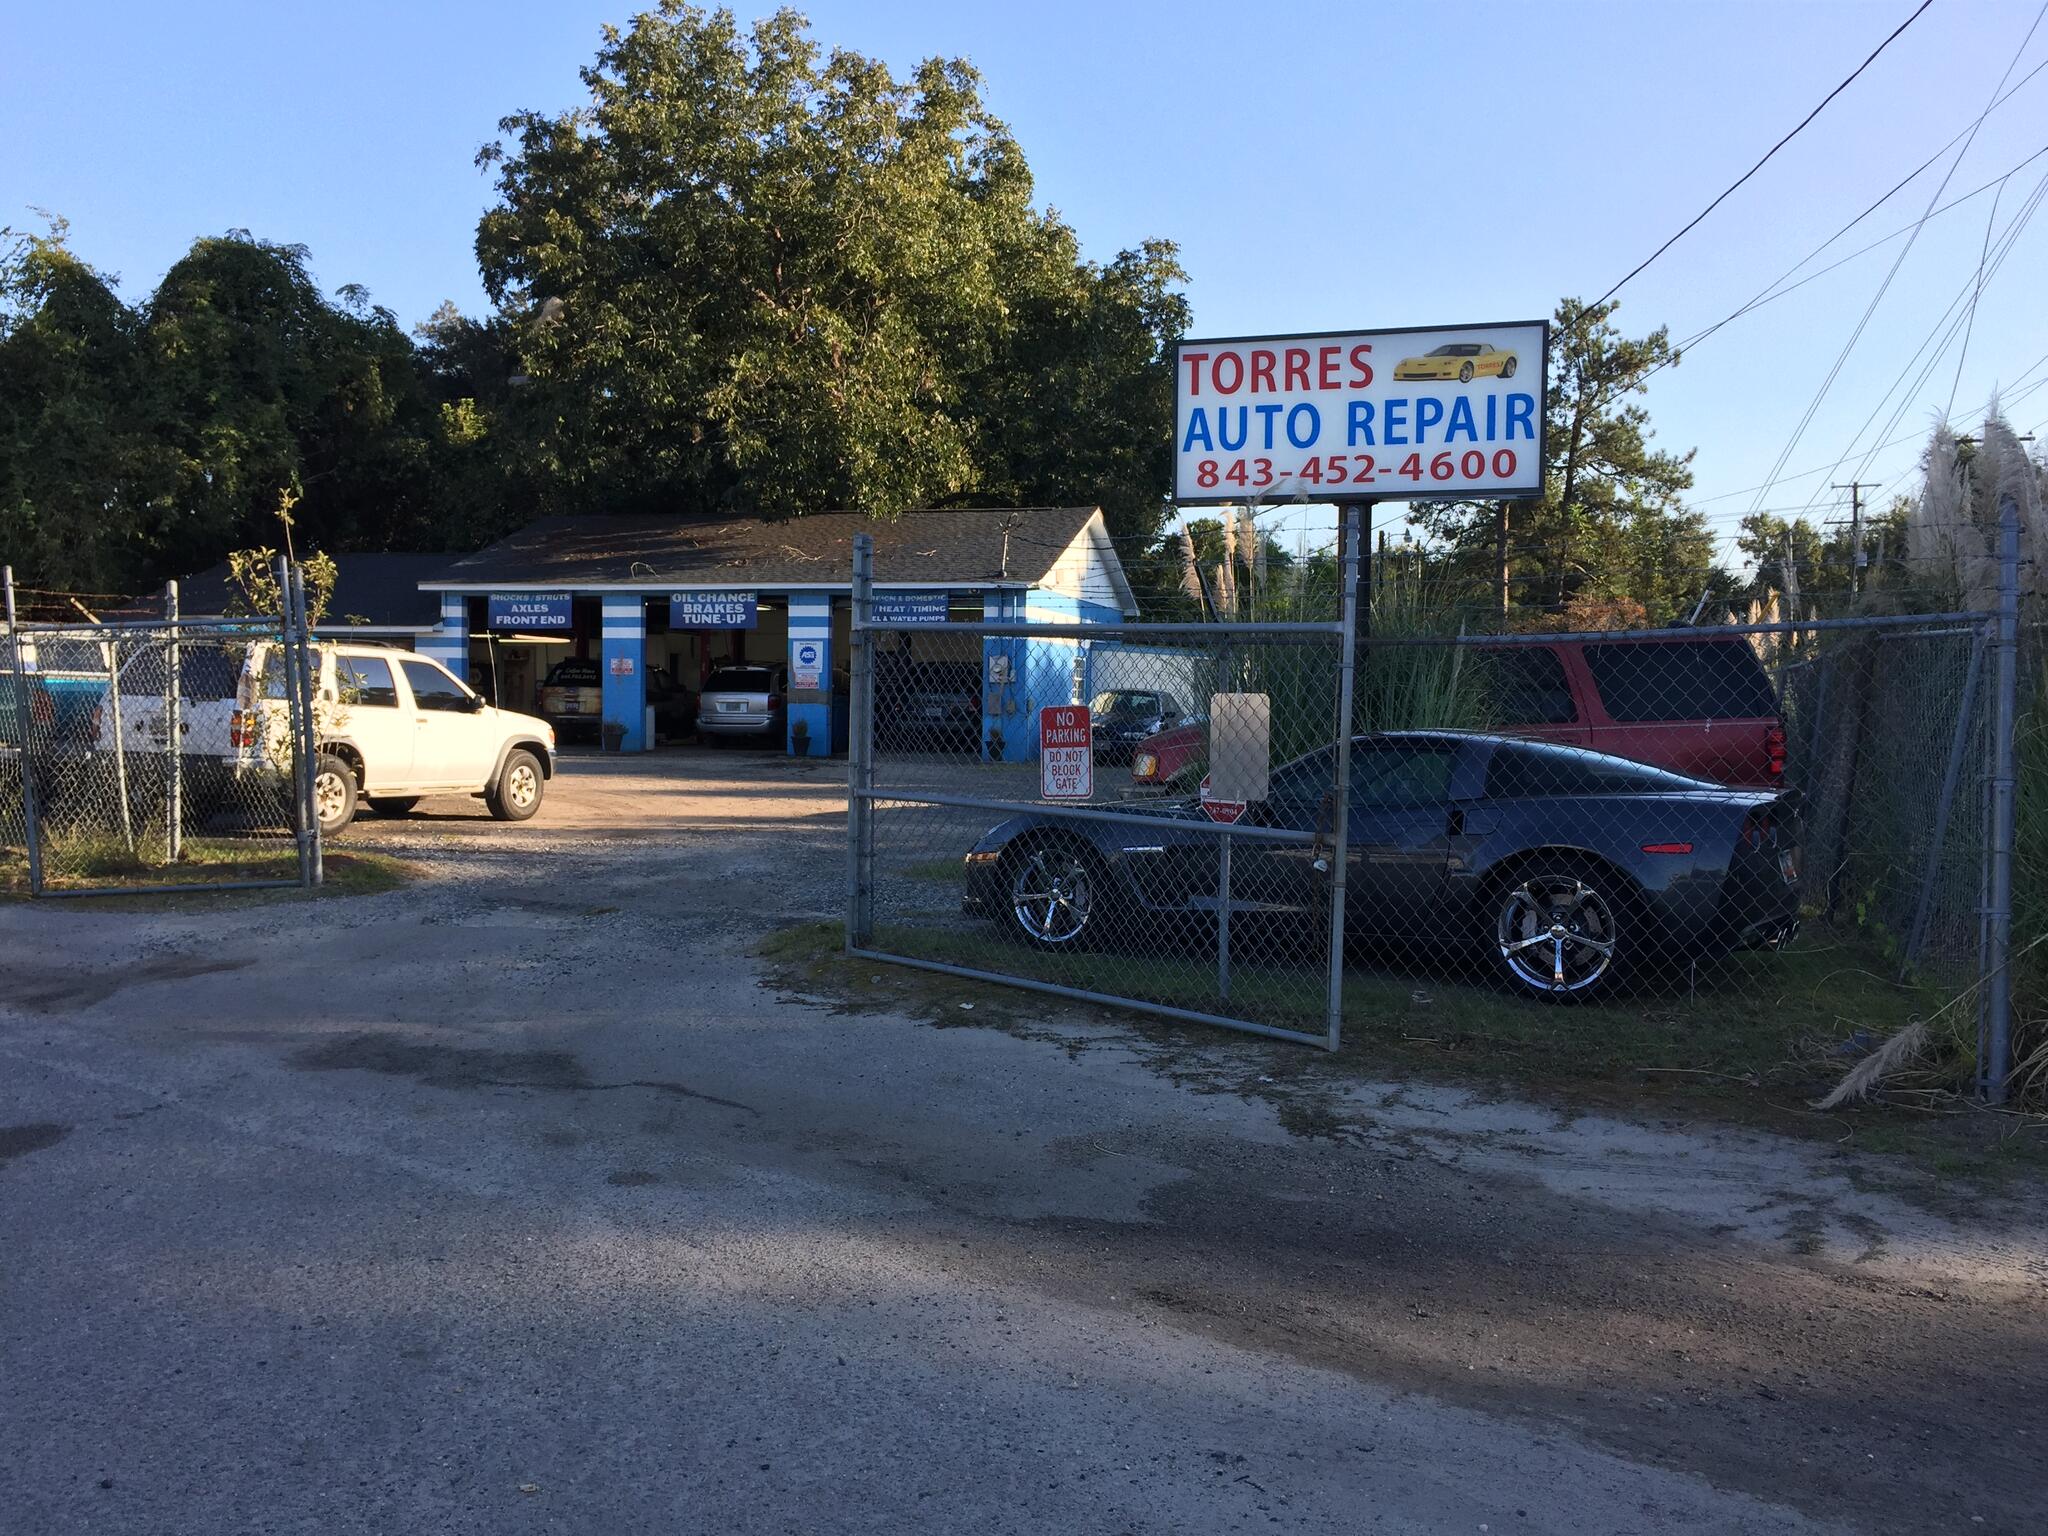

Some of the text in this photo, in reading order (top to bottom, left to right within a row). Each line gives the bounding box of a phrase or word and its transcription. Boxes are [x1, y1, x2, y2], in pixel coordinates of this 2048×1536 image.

[1183, 344, 1374, 396] TORRES
[1182, 393, 1535, 452] AUTO REPAIR
[1197, 449, 1517, 488] 843-452-4600
[672, 593, 756, 603] OIL CHANGE
[511, 604, 549, 613] AXLES
[683, 603, 745, 614] BRAKES
[879, 605, 905, 613] HEAT
[912, 605, 946, 613] TIMING
[496, 615, 566, 625] FRONT END
[682, 613, 746, 624] TUNE-UP
[1056, 711, 1074, 727] NO
[1046, 728, 1086, 743] PARKING
[1049, 750, 1083, 763] DO NOT
[1052, 764, 1081, 776] BLOCK
[1055, 777, 1078, 790] GATE
